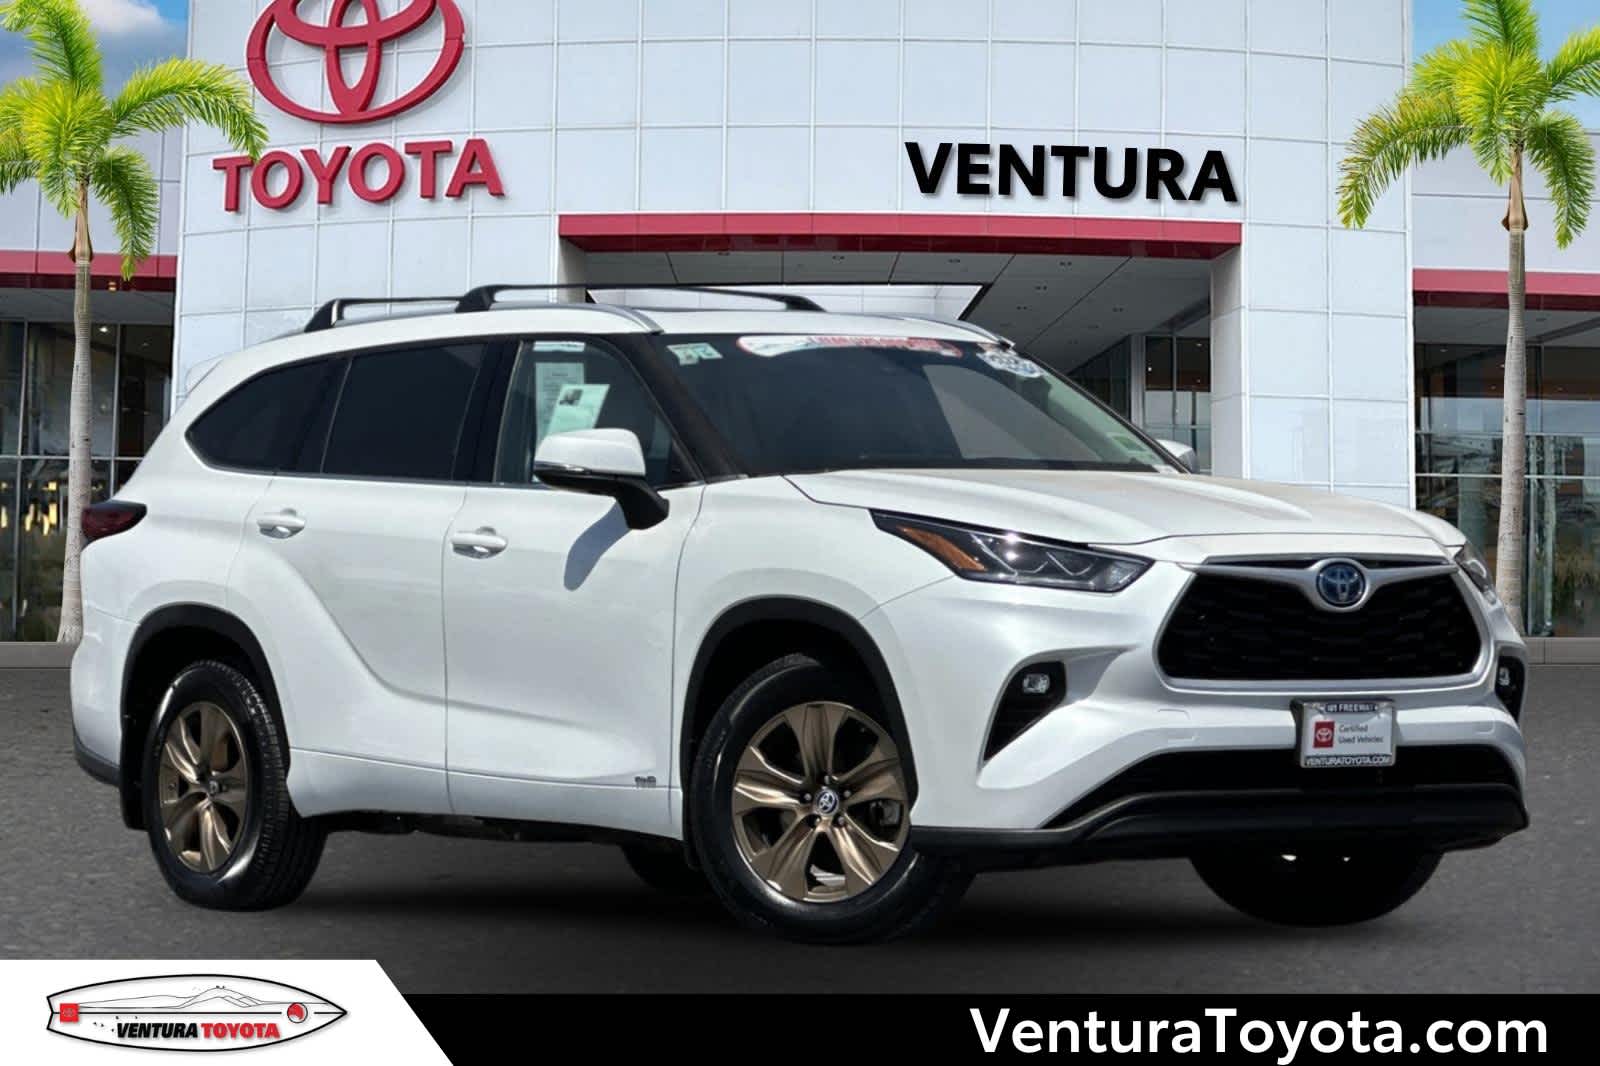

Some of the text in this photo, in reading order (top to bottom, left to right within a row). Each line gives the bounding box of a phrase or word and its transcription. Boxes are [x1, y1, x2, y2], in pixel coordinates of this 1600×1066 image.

[213, 138, 504, 212] TOYOTA
[905, 141, 1238, 203] VENTURA
[1338, 703, 1375, 712] FREEWAY
[1338, 724, 1368, 733] Certified
[1338, 735, 1384, 744] Used Vehicles
[1305, 756, 1391, 767] VENTURATOYOTA.COM
